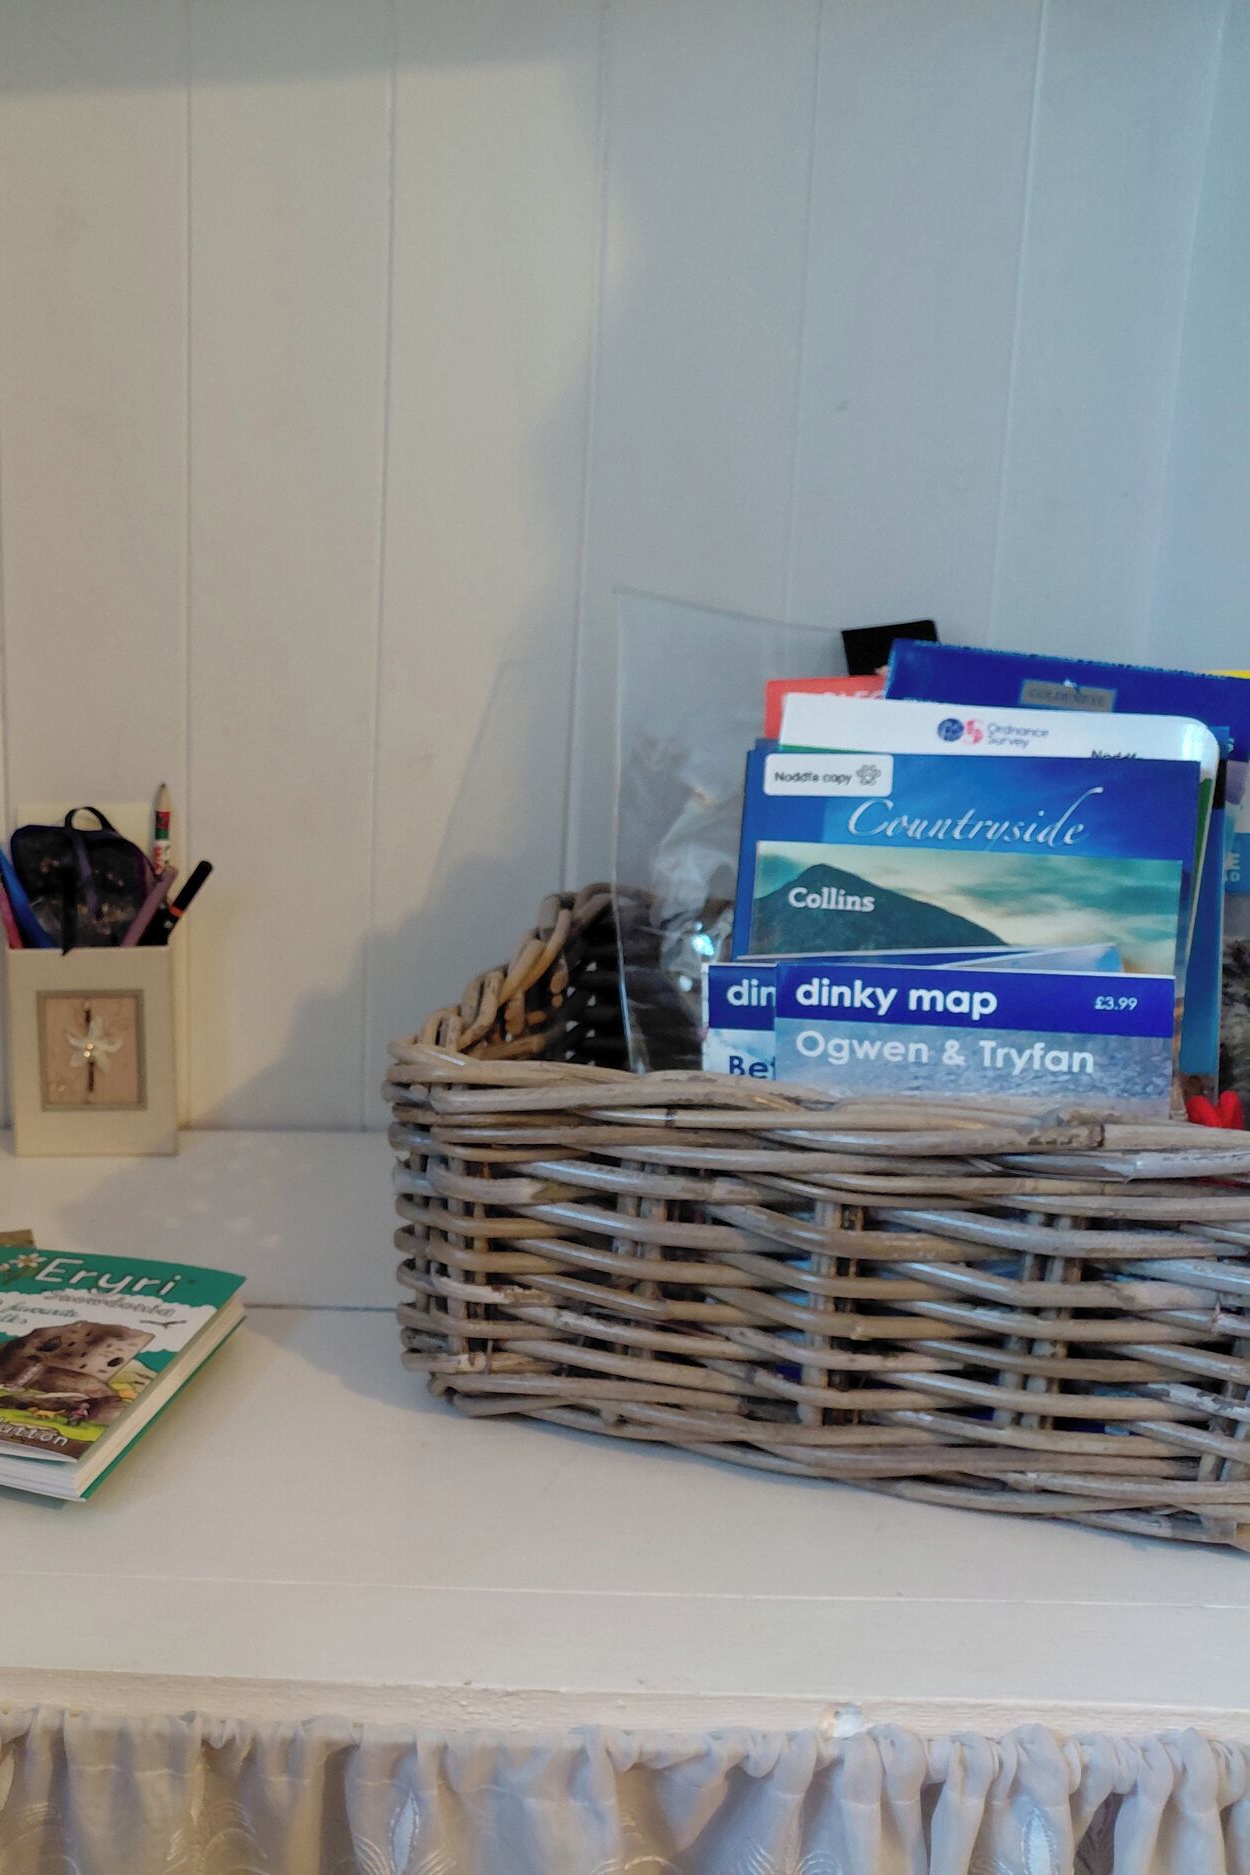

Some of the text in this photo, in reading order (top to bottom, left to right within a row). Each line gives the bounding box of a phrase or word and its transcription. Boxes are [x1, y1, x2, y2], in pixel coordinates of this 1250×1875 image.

[987, 721, 1050, 739] Ordnance
[988, 734, 1030, 749] Survey
[822, 773, 853, 786] copy
[848, 786, 1104, 851] Countryside
[788, 886, 875, 912] Collins
[795, 978, 998, 1021] dinky map
[1094, 995, 1139, 1012] £3.99
[796, 1030, 1095, 1076] Ogwen & Tryfan
[35, 1257, 182, 1297] Eryri
